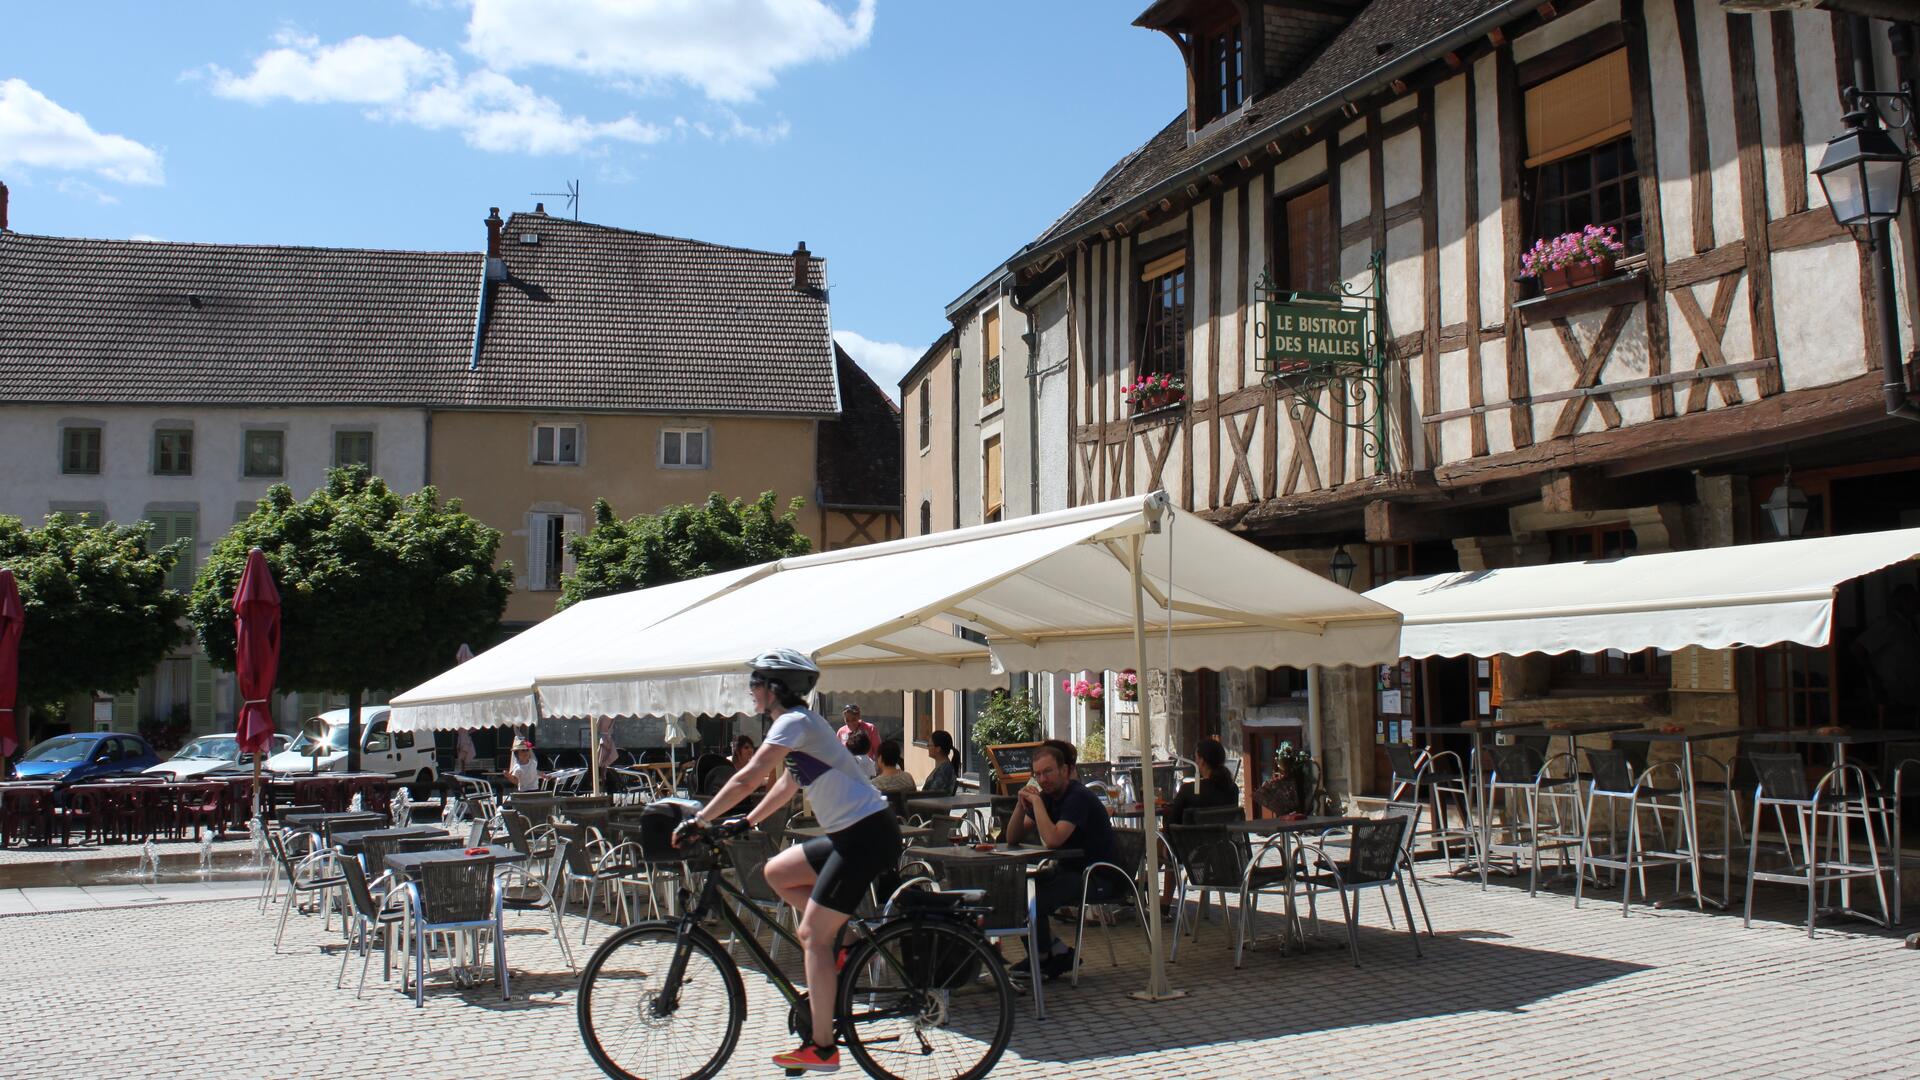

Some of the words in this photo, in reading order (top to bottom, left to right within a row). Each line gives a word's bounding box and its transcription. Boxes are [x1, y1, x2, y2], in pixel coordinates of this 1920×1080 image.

[1276, 315, 1293, 331] LE
[1299, 317, 1357, 335] BISTROT
[1275, 336, 1302, 352] DES
[1308, 338, 1360, 356] HALLES
